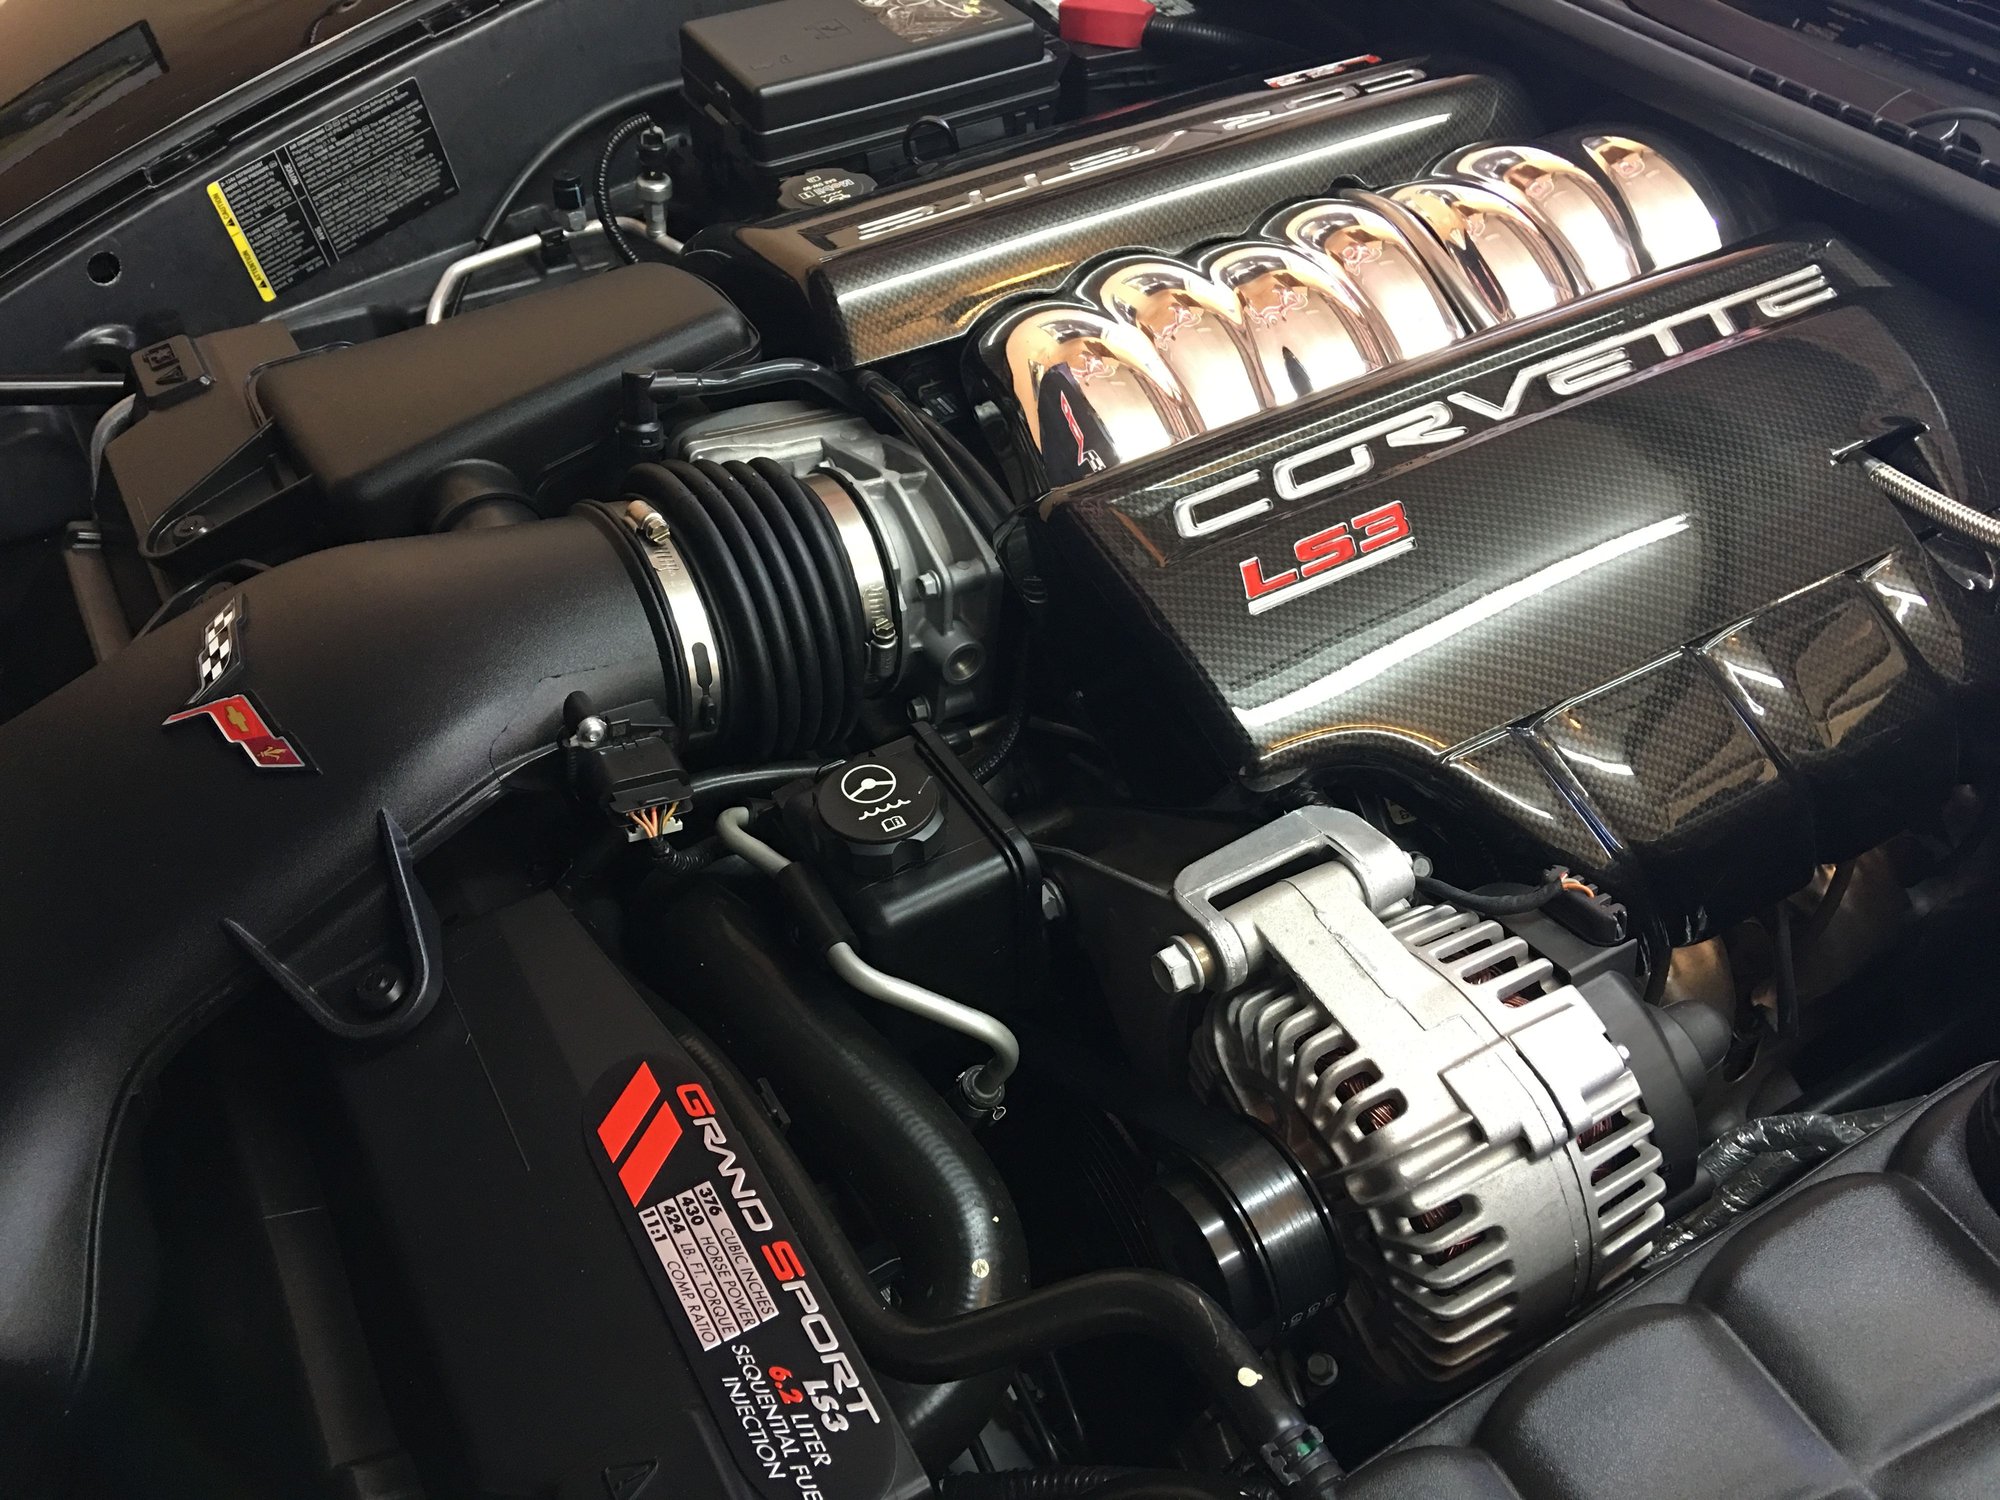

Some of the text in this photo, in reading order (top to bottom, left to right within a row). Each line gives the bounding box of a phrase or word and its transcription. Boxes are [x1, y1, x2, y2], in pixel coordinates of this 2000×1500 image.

[212, 193, 230, 219] CAUTION
[284, 163, 299, 186] NOTICE
[242, 250, 263, 281] ATTENTION
[1173, 264, 1838, 538] CORVETTE
[1239, 500, 1413, 600] LS3
[643, 1211, 716, 1344] 11:1 COMP. RATIO
[662, 1205, 736, 1335] 424 LB. FT. TORQUE
[676, 1083, 880, 1424] GRAND SPORT
[681, 1196, 756, 1326] 430 HORSE POWER
[698, 1187, 775, 1316] 376 CUBIC INCHES
[722, 1377, 786, 1479] INJECTION
[731, 1344, 824, 1500] SEQUENTIAL FUE
[768, 1366, 832, 1467] 6.2 LITER
[802, 1380, 849, 1433] LS3
